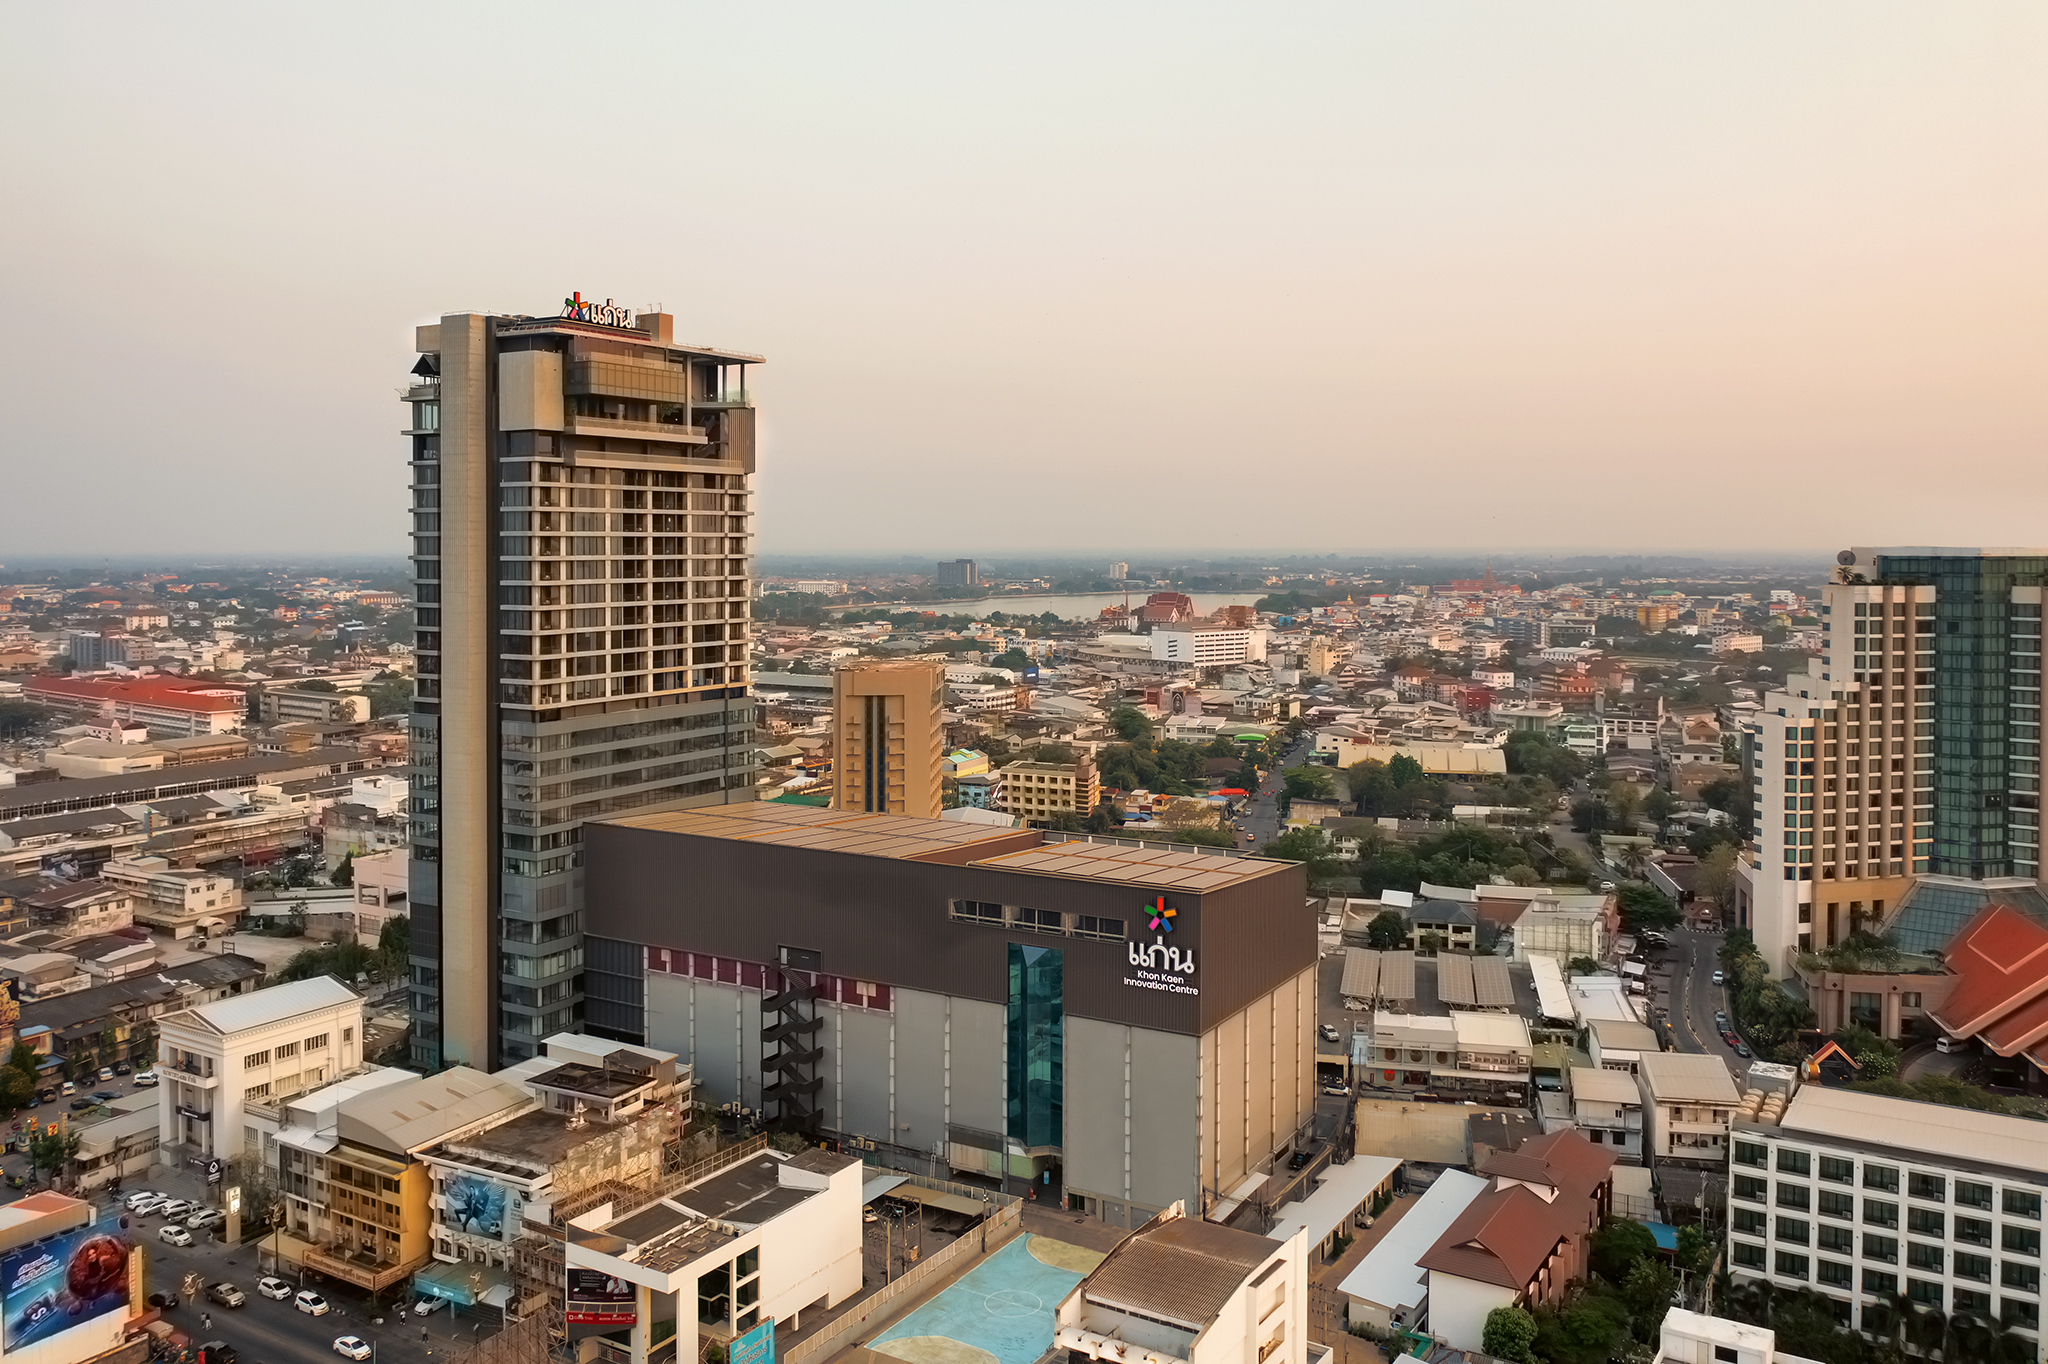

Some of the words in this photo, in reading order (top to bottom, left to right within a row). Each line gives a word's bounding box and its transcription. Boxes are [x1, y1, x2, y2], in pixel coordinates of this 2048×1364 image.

[589, 298, 632, 328] แก่น
[1129, 935, 1194, 973] แก่น
[1123, 977, 1168, 991] Innovation
[1169, 984, 1199, 995] Centre
[1137, 970, 1160, 981] Khon
[1161, 973, 1184, 984] Kaen
